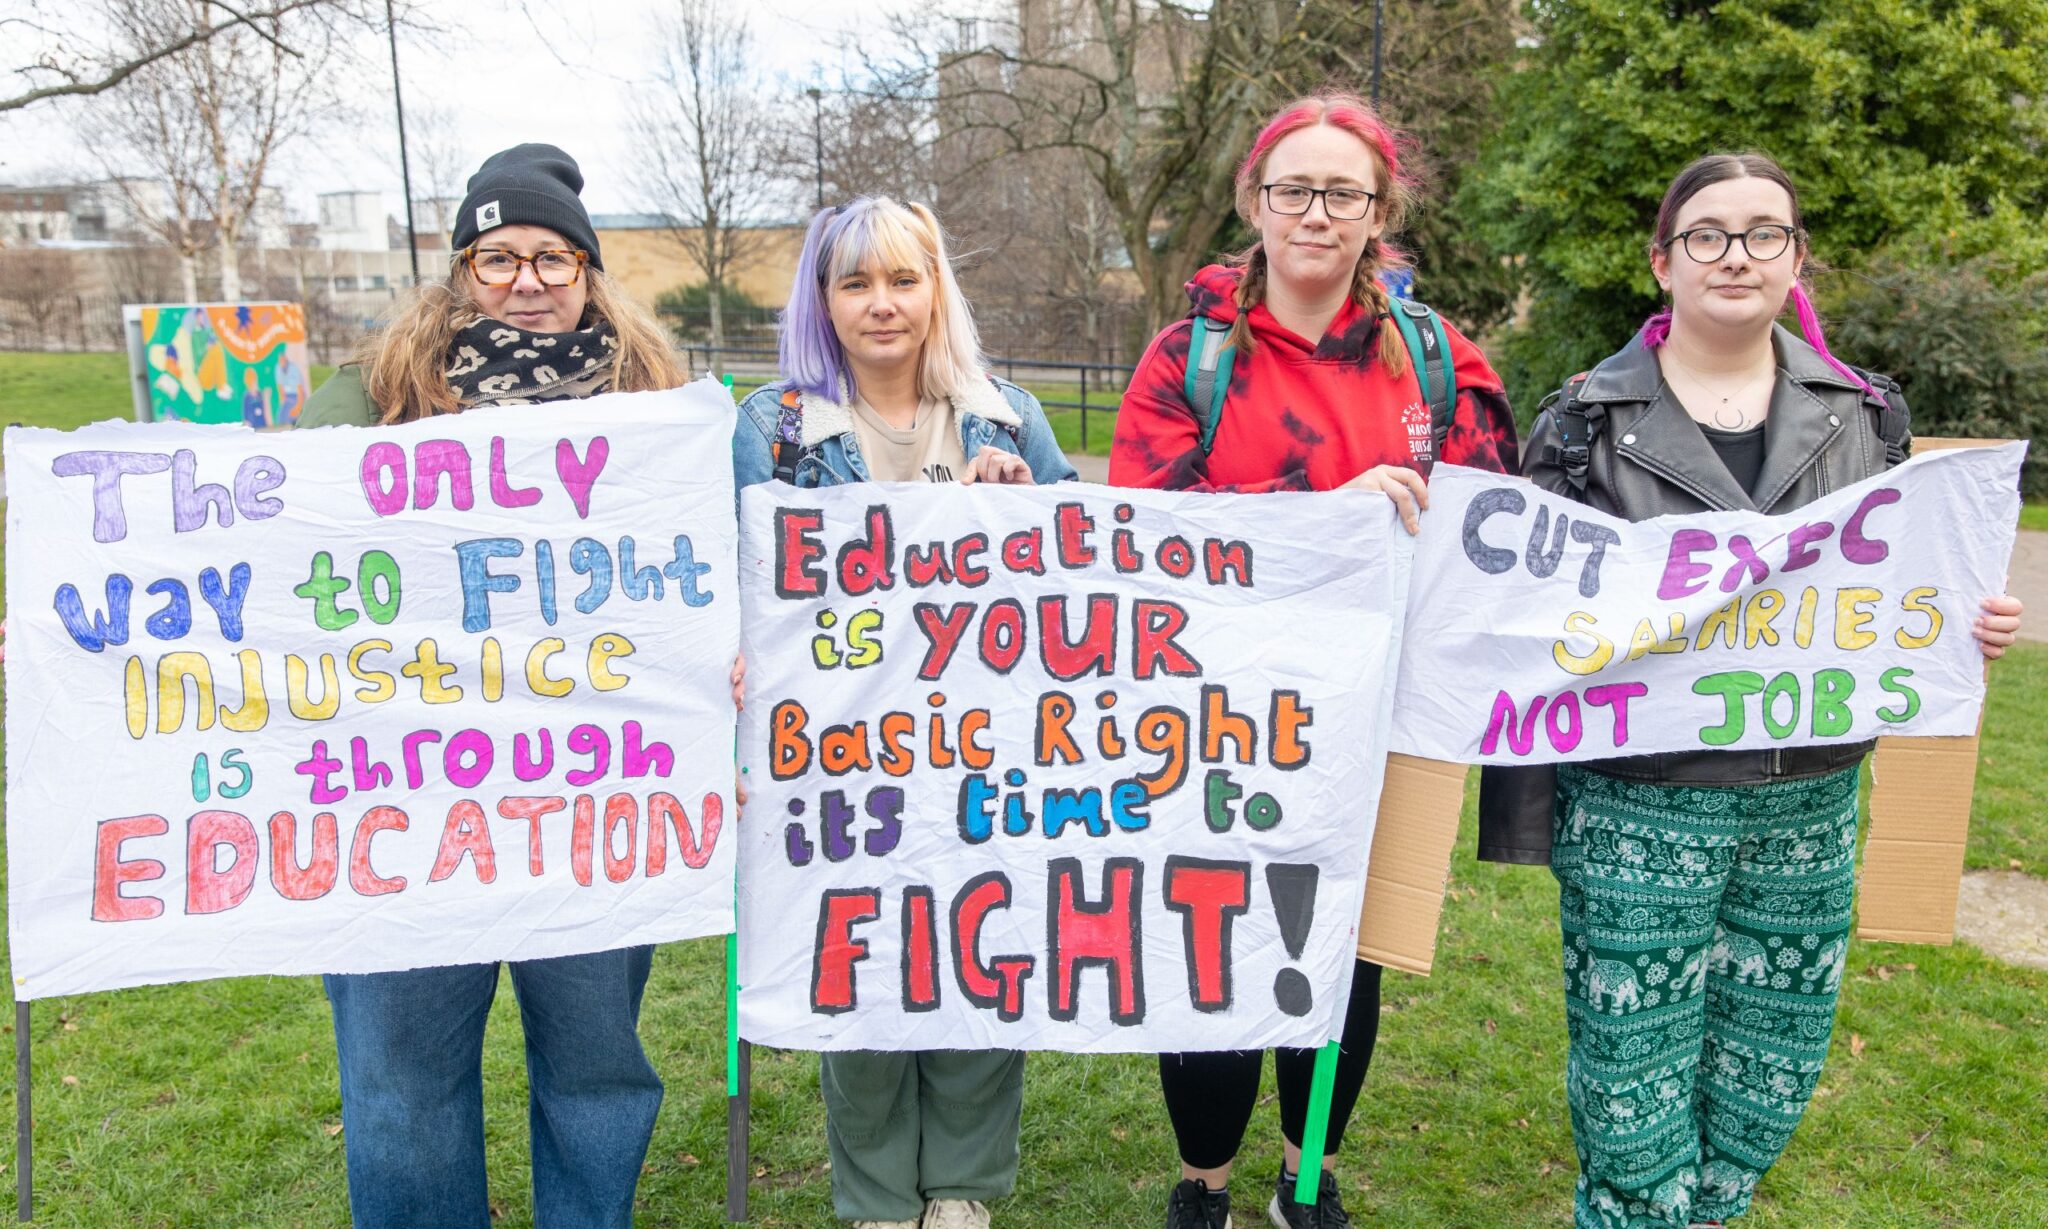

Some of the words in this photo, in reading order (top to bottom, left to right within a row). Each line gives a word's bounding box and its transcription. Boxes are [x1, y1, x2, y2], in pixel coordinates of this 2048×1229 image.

[1409, 440, 1433, 453] PSIDE
[52, 449, 287, 542] The
[773, 502, 1254, 599] Education
[1462, 487, 1621, 598] CUT
[1657, 488, 1901, 601] EXEC
[812, 607, 885, 670] is
[914, 593, 1203, 682] YOUR
[1552, 586, 1944, 675] SALARIES
[769, 692, 994, 781] Basic
[1035, 684, 1314, 801] Right
[1480, 681, 1648, 756] NOT
[1692, 667, 1921, 746] JOBS
[295, 720, 675, 804] through
[91, 791, 723, 922] EDUCATION
[785, 786, 903, 866] its
[957, 768, 1152, 844] time
[1204, 768, 1283, 832] to
[810, 855, 1320, 1025] FIGHT!
